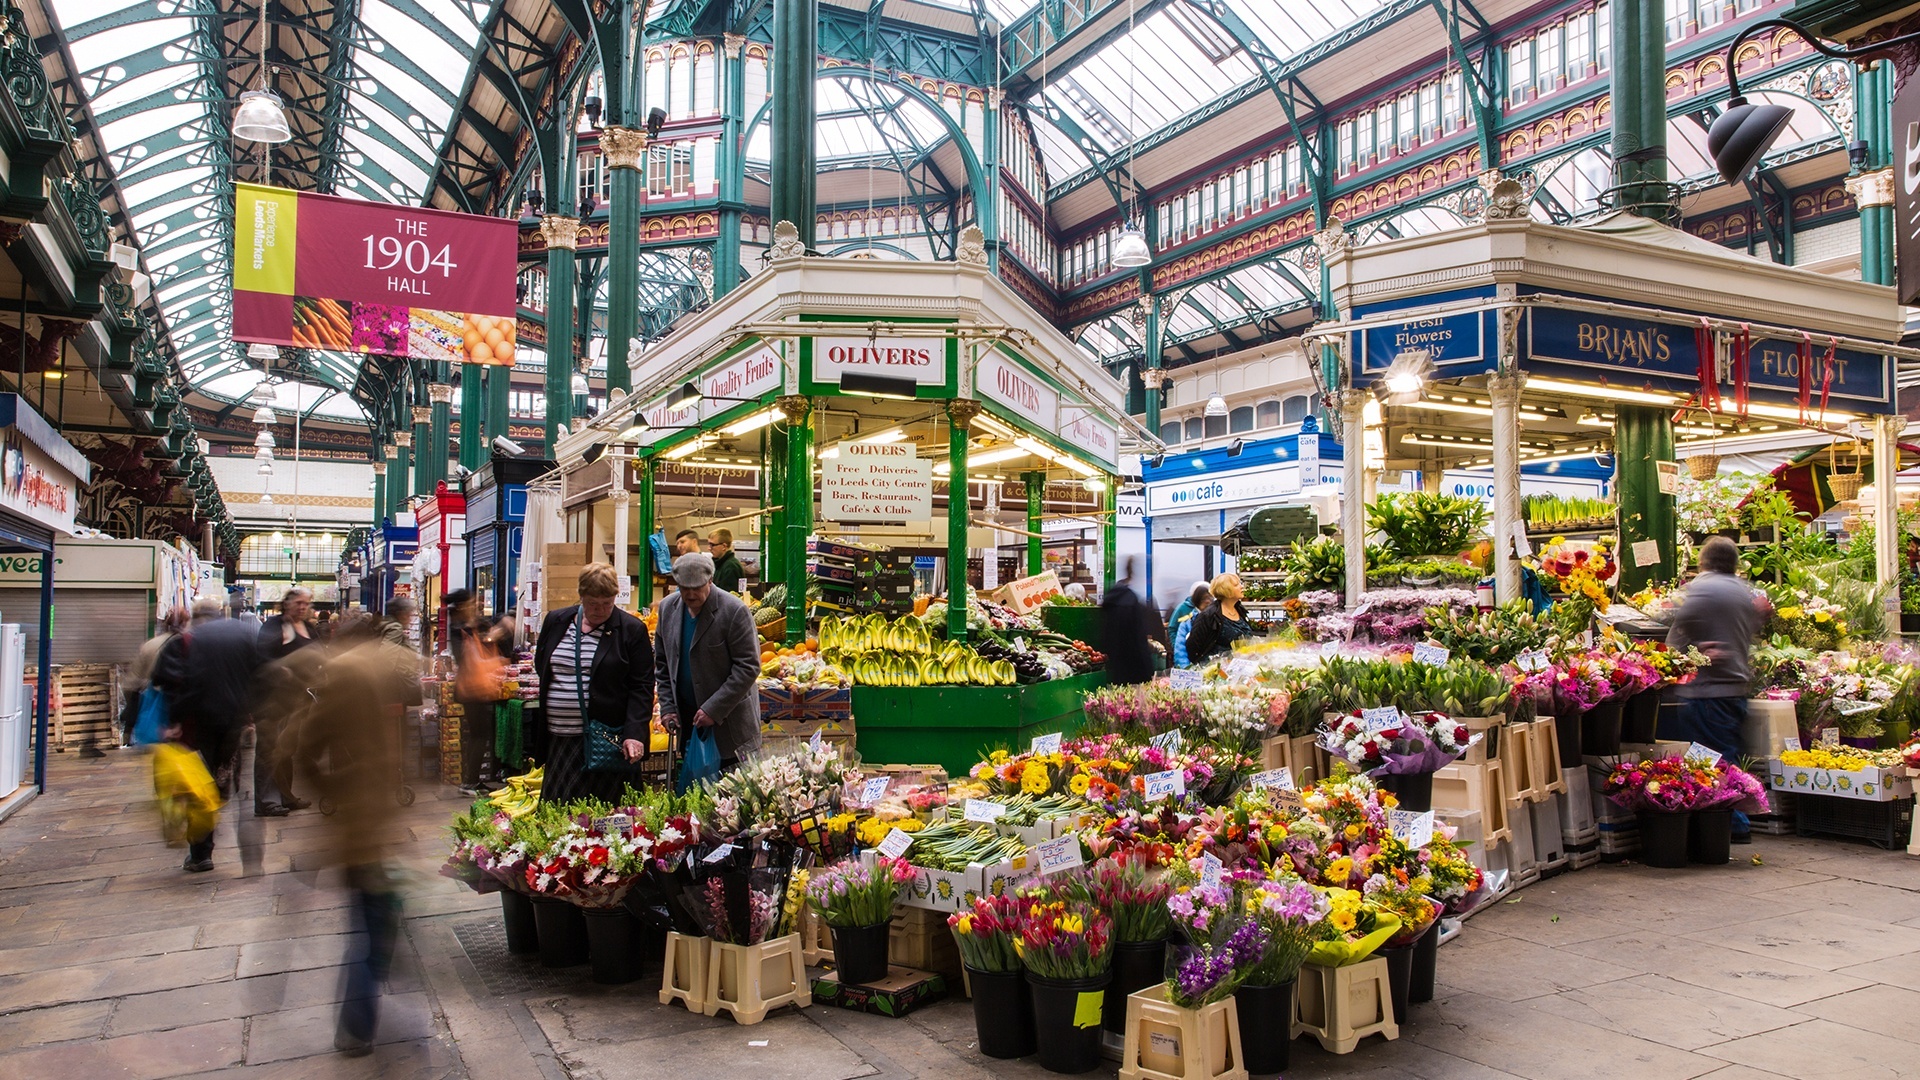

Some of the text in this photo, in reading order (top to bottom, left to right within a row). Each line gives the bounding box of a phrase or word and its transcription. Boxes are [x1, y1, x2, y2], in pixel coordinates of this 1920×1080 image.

[266, 201, 279, 248] Experience
[395, 218, 428, 237] THE
[362, 234, 458, 278] 1904
[387, 276, 431, 296] HALL
[1395, 328, 1453, 347] Flowers
[1577, 323, 1672, 366] BRIAN'S
[828, 344, 931, 367] OLIVERS
[1403, 345, 1445, 359] ily
[710, 354, 775, 407] Quality Fruits
[997, 365, 1040, 416] OLIVERS
[904, 434, 925, 443] HILIPS
[1071, 411, 1108, 451] Quality Fruits
[849, 444, 907, 456] OLIVERS
[655, 463, 749, 478] EL: 0113 245 4337
[836, 464, 919, 475] Free Deliveries
[840, 478, 869, 487] Leeds
[871, 478, 891, 490] City
[894, 478, 927, 488] Centre
[1006, 487, 1089, 500] & COECTIONERY
[1196, 481, 1223, 500] cafe
[831, 490, 922, 503] Bars, Restaurants,
[841, 503, 912, 515] Cafe's & Clubs
